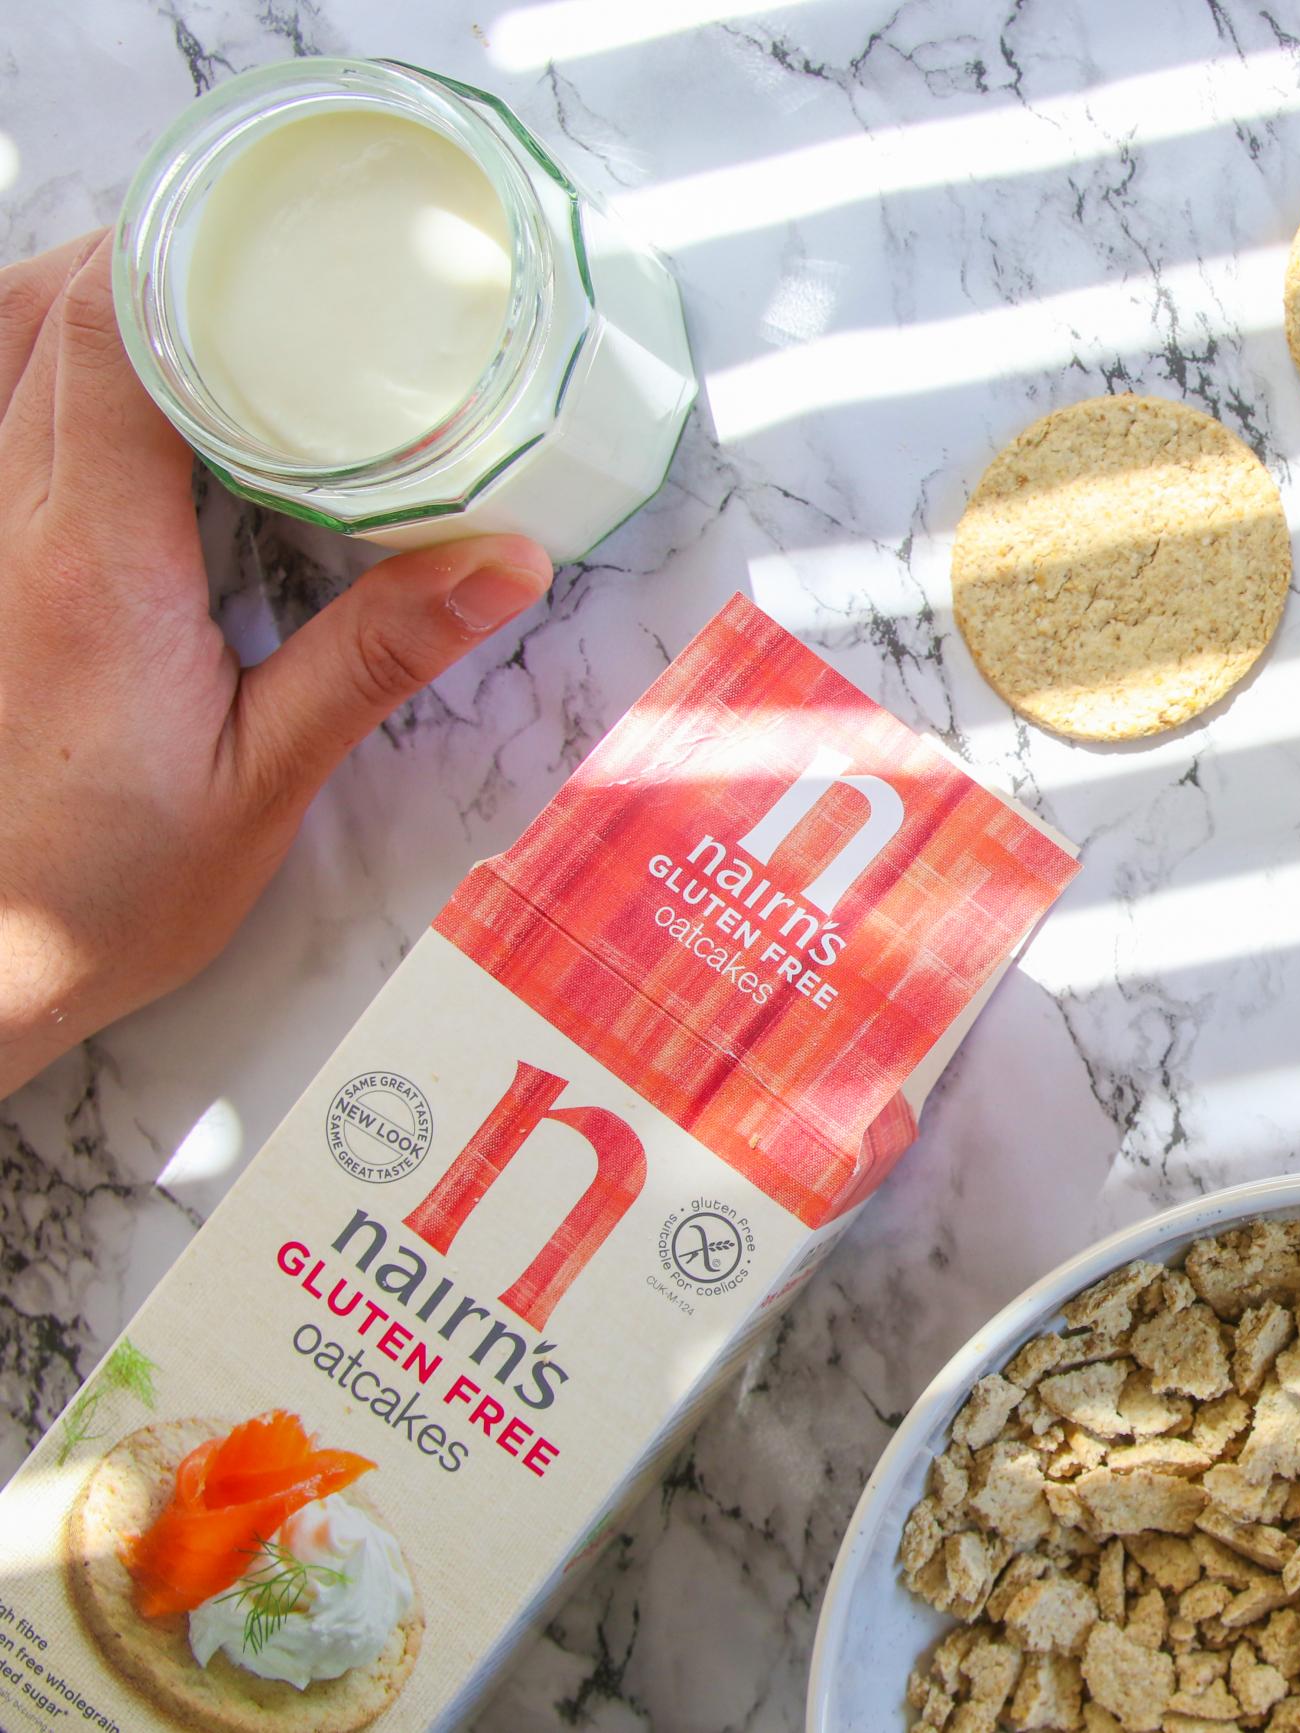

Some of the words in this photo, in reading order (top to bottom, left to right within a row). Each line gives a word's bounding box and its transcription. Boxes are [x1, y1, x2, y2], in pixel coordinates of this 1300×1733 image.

[736, 746, 905, 916] n
[648, 854, 761, 949] GLUTEN
[759, 942, 839, 1010] FREE
[686, 834, 847, 967] nairn's
[654, 905, 774, 1005] oatcakes
[330, 1113, 343, 1150] SAME
[338, 1150, 374, 1179] GREAT
[377, 1156, 414, 1180] TASTE
[335, 1096, 377, 1129] NEW
[376, 1122, 424, 1160] LOOK
[344, 1076, 377, 1099] SAME
[380, 1076, 419, 1101] GREAT
[414, 1101, 429, 1142] TASTE
[401, 1059, 649, 1334] n
[691, 1196, 738, 1219] gluten
[737, 1217, 756, 1252] free
[658, 1213, 678, 1271] suitable
[670, 1271, 693, 1291] for
[696, 1268, 749, 1297] coeliacs
[276, 1240, 443, 1385] GLUTEN
[443, 1374, 561, 1478] FREE
[330, 1208, 571, 1410] nairn's
[292, 1323, 469, 1473] oatcakes
[0, 1598, 15, 1624] gh
[15, 1618, 48, 1651] fibre
[15, 1647, 44, 1676] free
